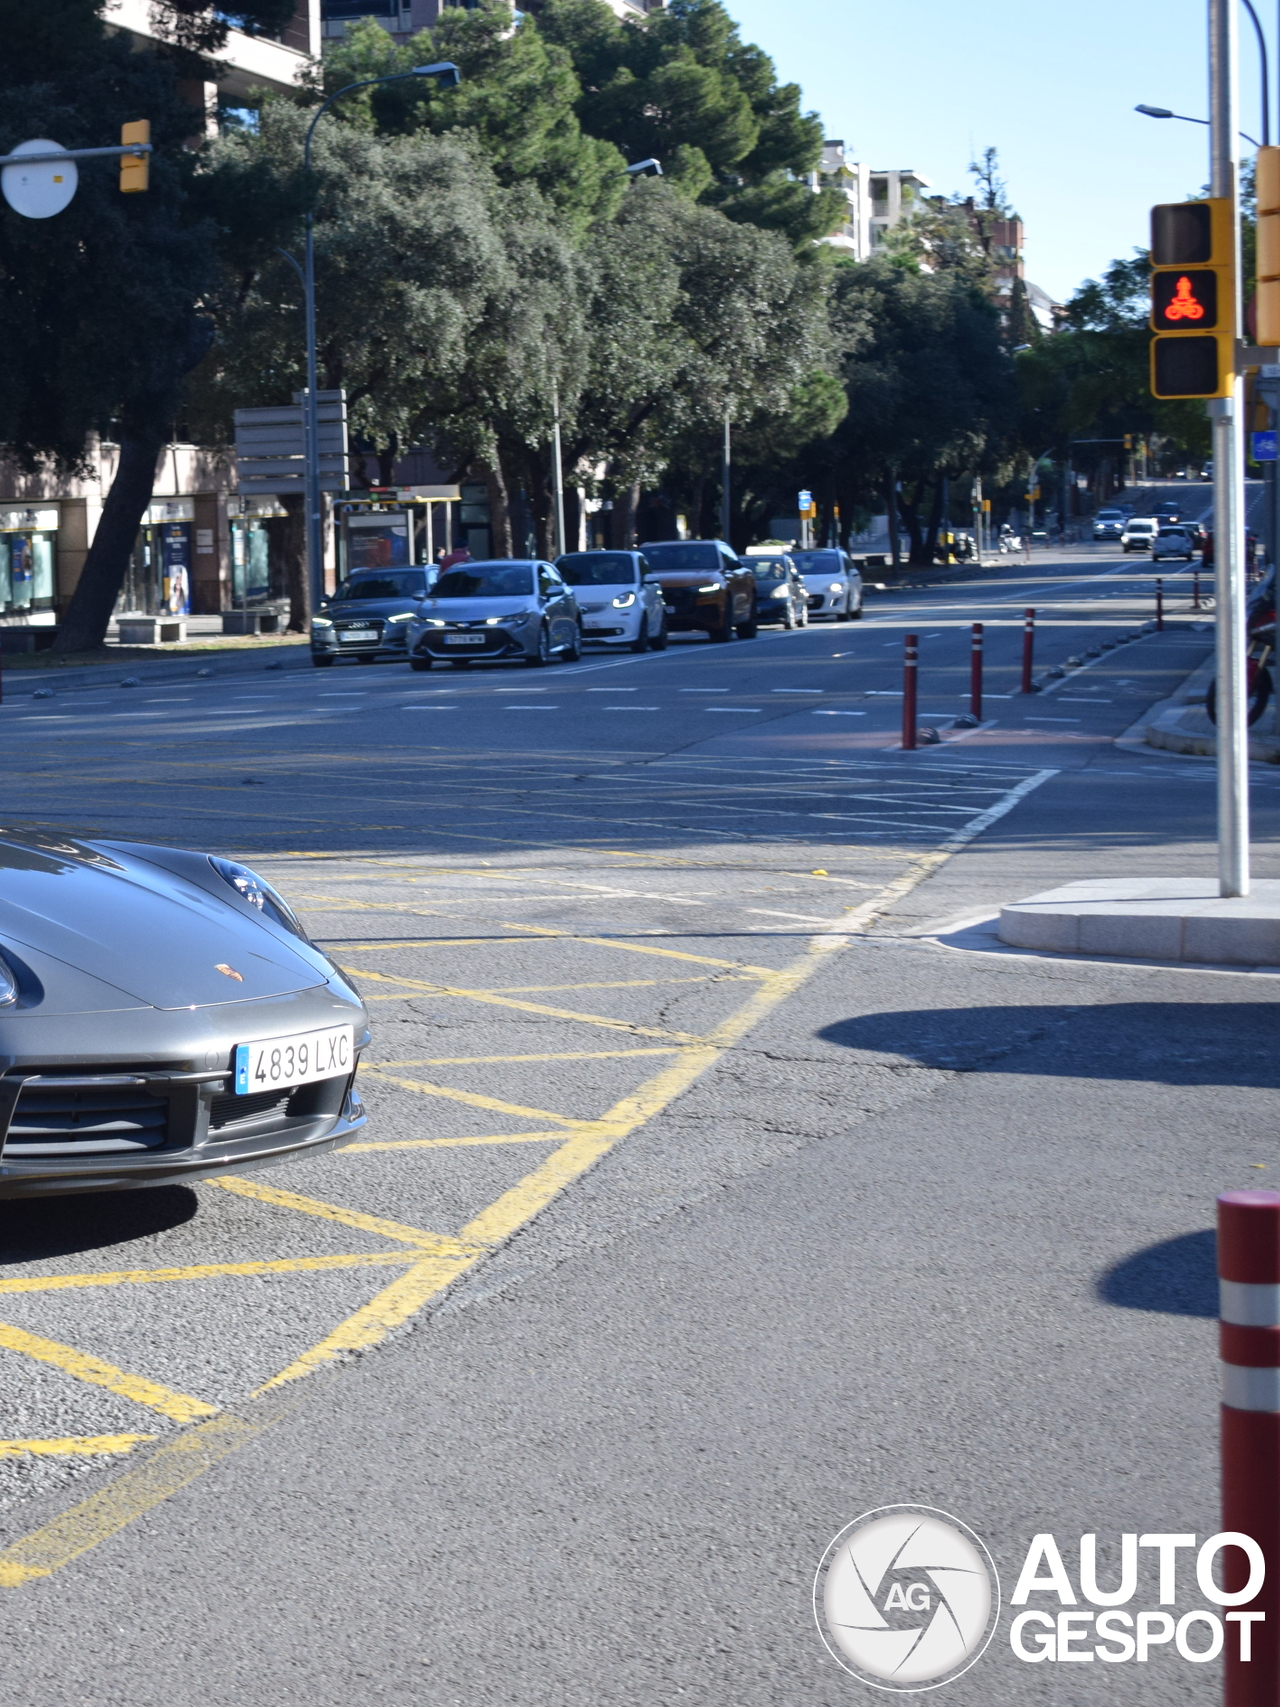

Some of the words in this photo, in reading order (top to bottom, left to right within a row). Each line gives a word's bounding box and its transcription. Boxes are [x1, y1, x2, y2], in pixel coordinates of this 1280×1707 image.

[255, 1043, 309, 1083] 4839
[315, 1034, 348, 1073] LXC
[239, 1074, 246, 1085] E
